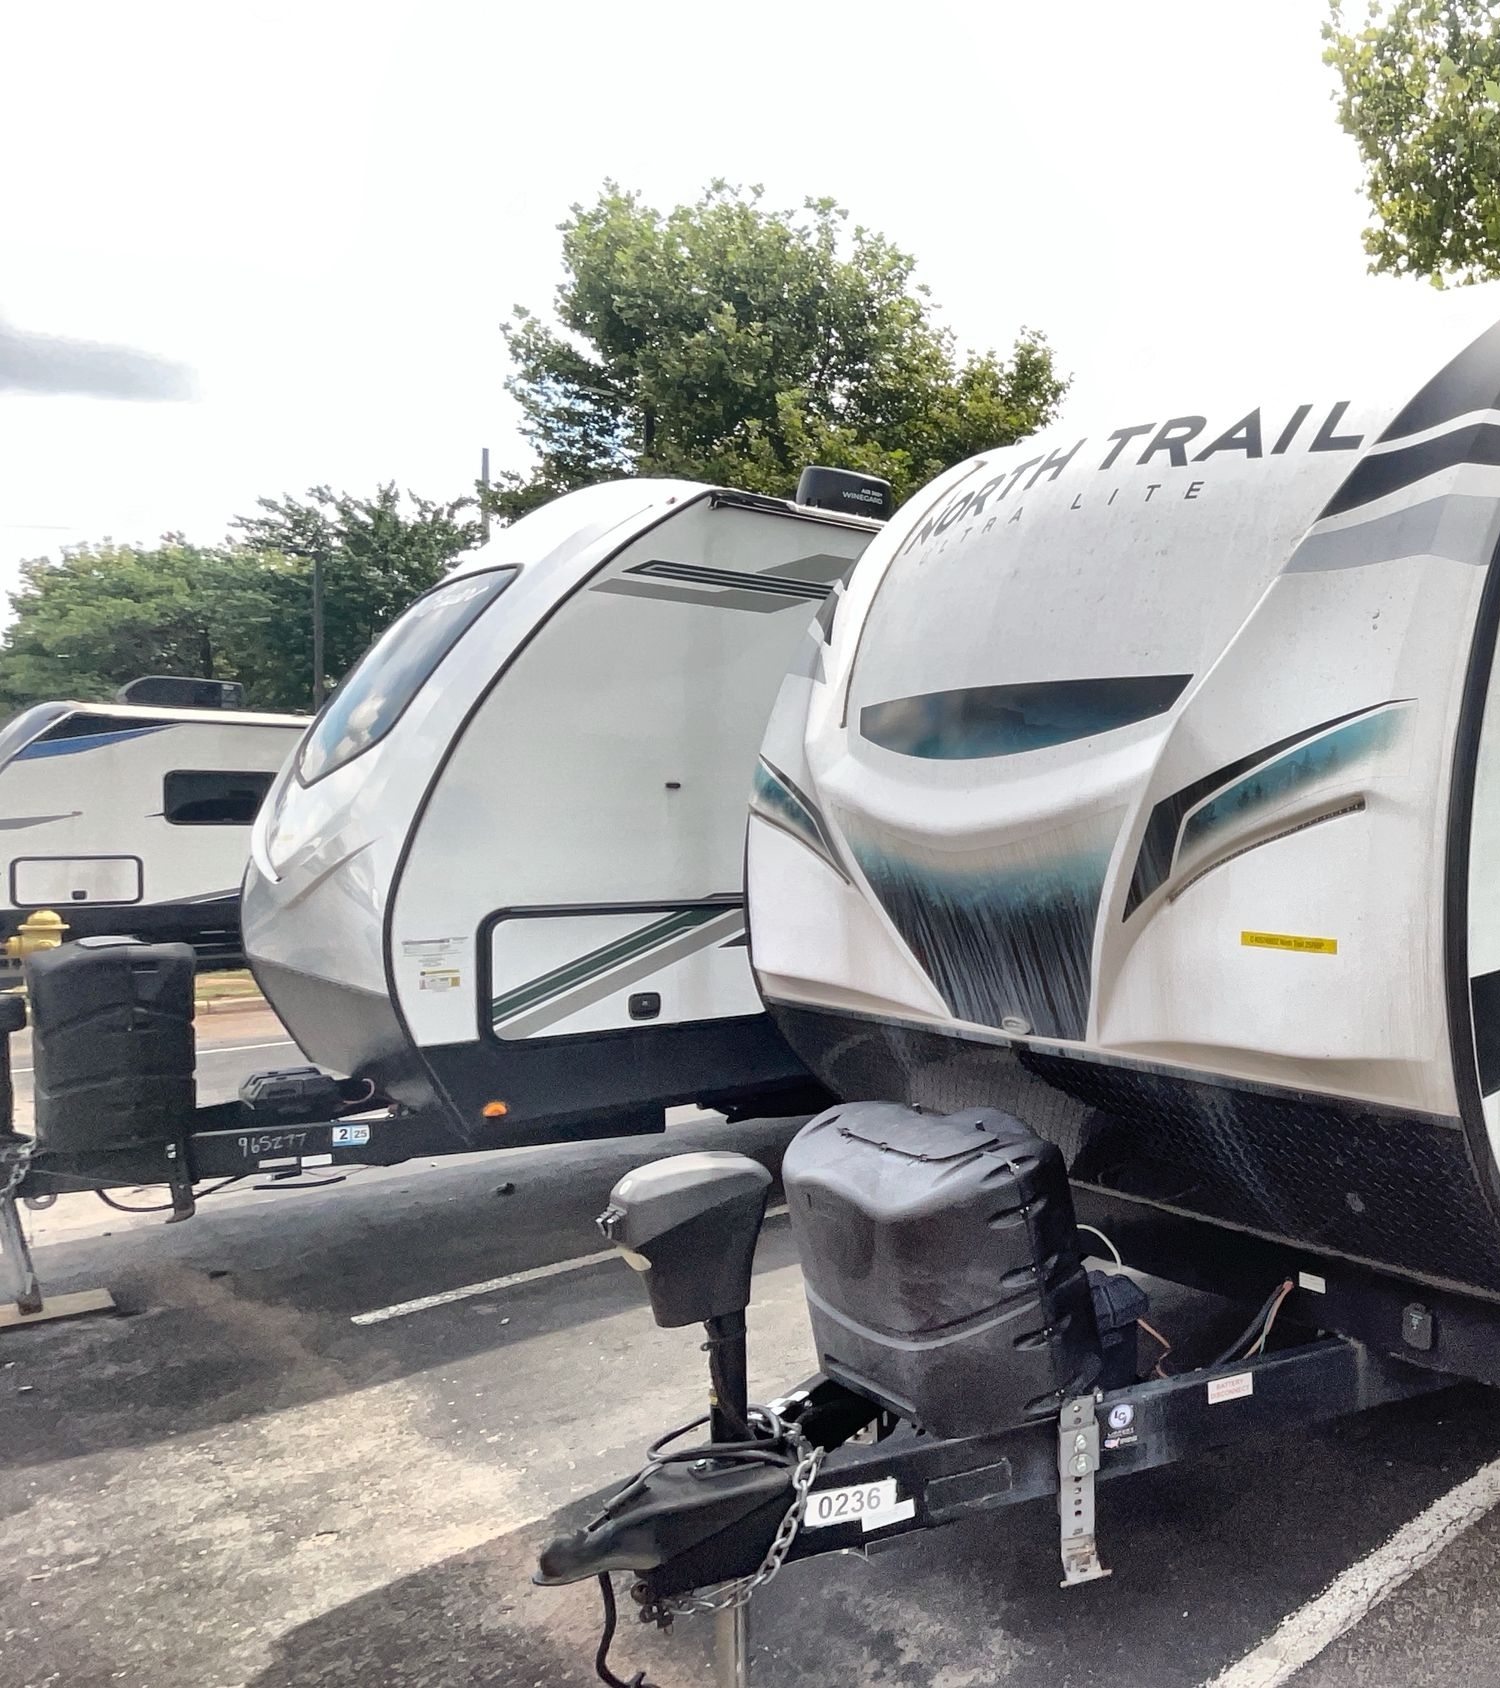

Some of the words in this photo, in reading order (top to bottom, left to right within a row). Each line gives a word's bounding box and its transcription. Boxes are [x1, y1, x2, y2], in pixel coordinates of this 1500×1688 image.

[903, 437, 1087, 555] NORTH
[1098, 400, 1365, 469] TRAIL
[842, 491, 883, 505] WINEGARD
[1070, 480, 1205, 511] LITE
[339, 1128, 348, 1140] 2
[354, 1129, 367, 1139] 25
[818, 1486, 882, 1520] 0236
